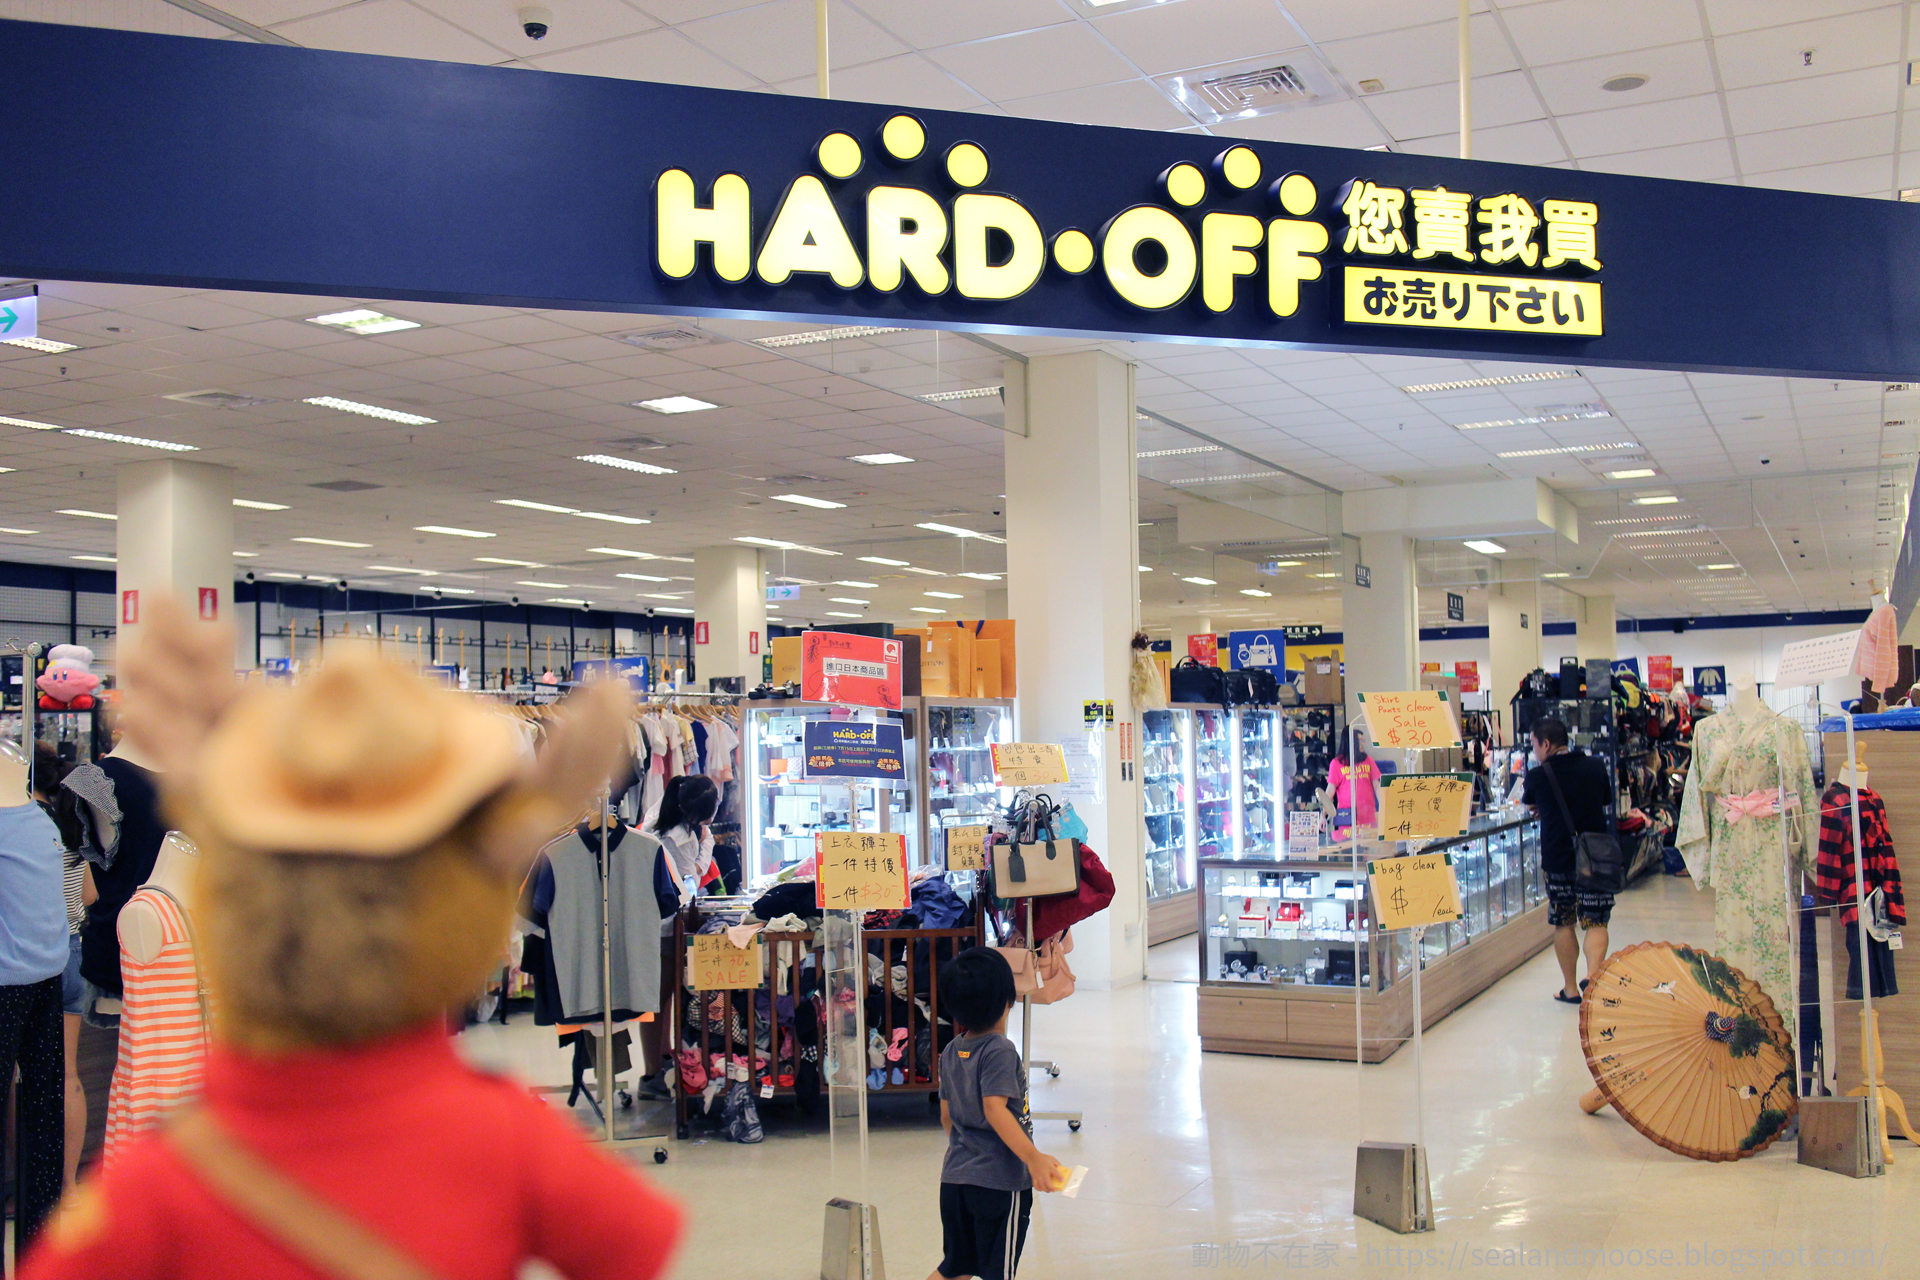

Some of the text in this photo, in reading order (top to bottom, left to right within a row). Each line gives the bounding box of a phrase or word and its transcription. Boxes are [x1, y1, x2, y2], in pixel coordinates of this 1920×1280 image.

[1342, 180, 1602, 271] 您賣我買
[1363, 275, 1585, 326] お売り下さい
[826, 661, 885, 677] 進口日本商品區
[1373, 694, 1400, 704] Skirt
[1393, 715, 1427, 728] Sale
[829, 857, 897, 876] 一件特價
[1380, 862, 1406, 881] bag
[704, 970, 748, 986] SALE
